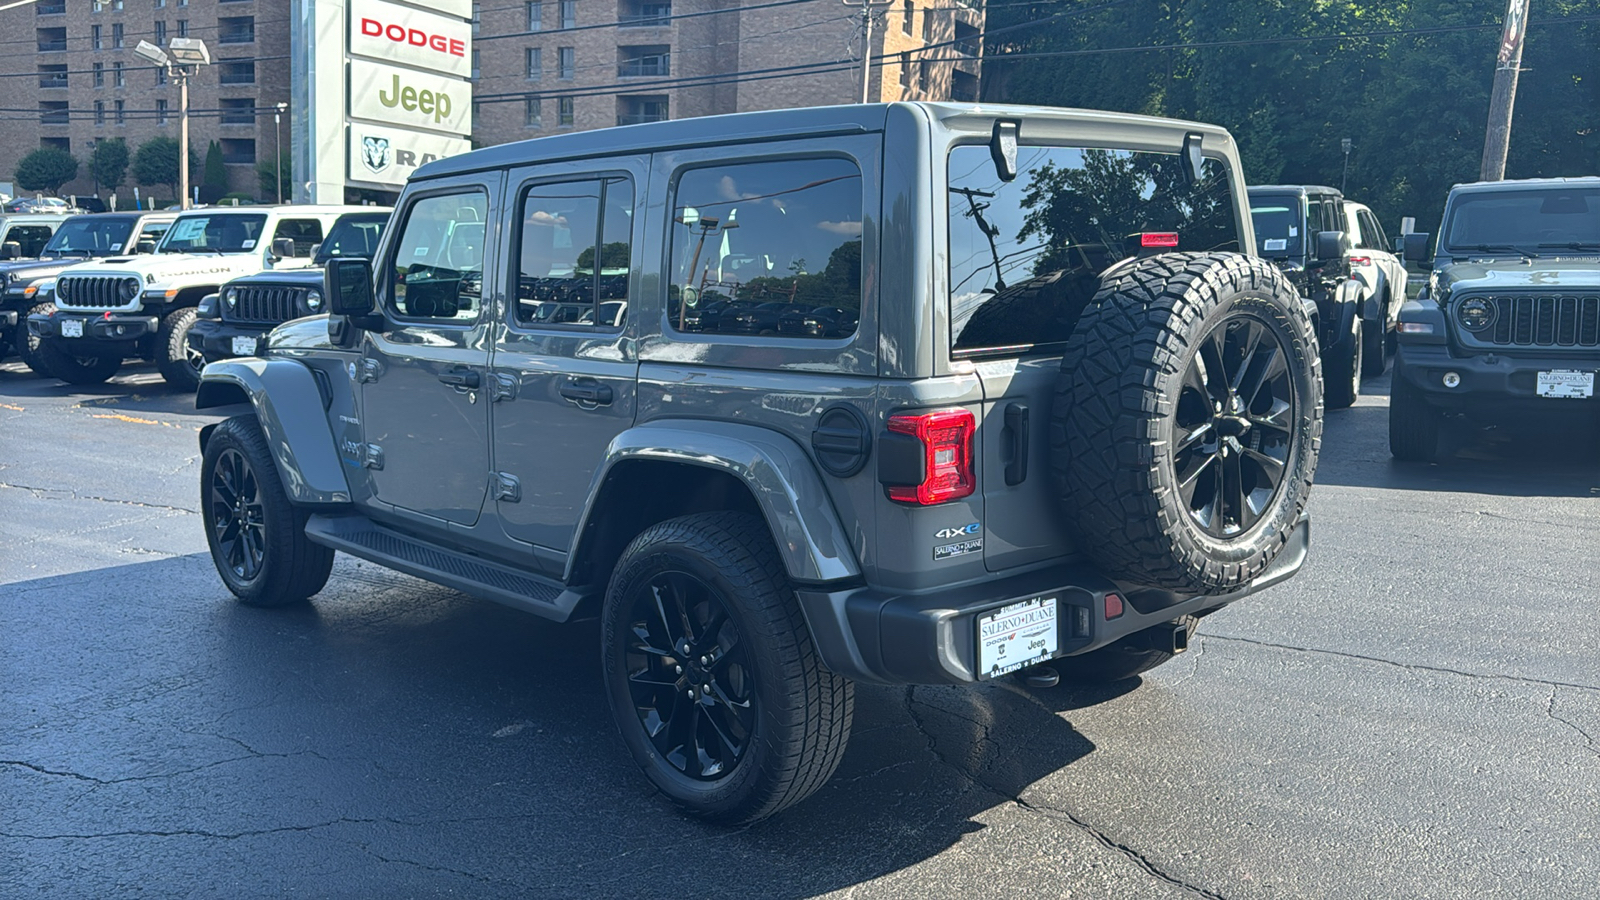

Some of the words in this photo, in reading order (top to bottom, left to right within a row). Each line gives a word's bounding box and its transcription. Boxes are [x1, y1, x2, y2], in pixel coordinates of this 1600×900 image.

[361, 17, 465, 58] DODGE
[379, 74, 452, 124] Jeep
[396, 149, 447, 168] RA
[982, 616, 1021, 638] SALERNO
[1025, 606, 1055, 624] DUANE
[1027, 638, 1046, 651] Jeep
[990, 663, 1022, 679] SALERNO
[1031, 653, 1053, 666] DUANE
